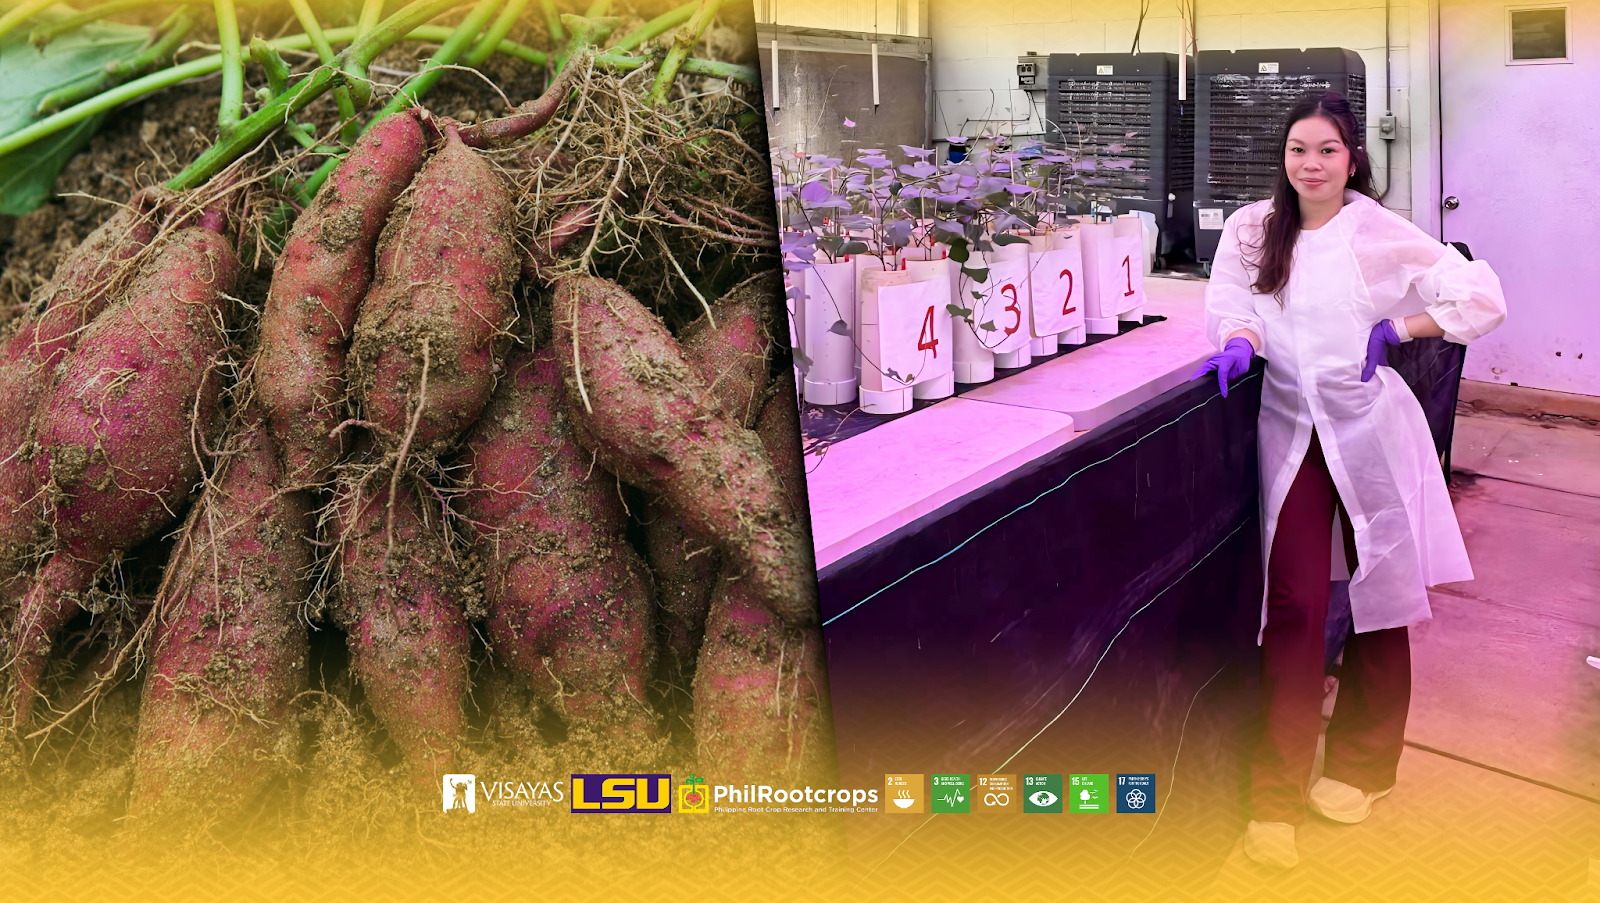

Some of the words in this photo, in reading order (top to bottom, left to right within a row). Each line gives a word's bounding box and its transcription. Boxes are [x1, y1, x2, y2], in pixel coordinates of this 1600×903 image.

[1059, 269, 1076, 315] 2
[1121, 255, 1135, 297] 1
[917, 305, 938, 359] 4
[1001, 283, 1021, 336] 3
